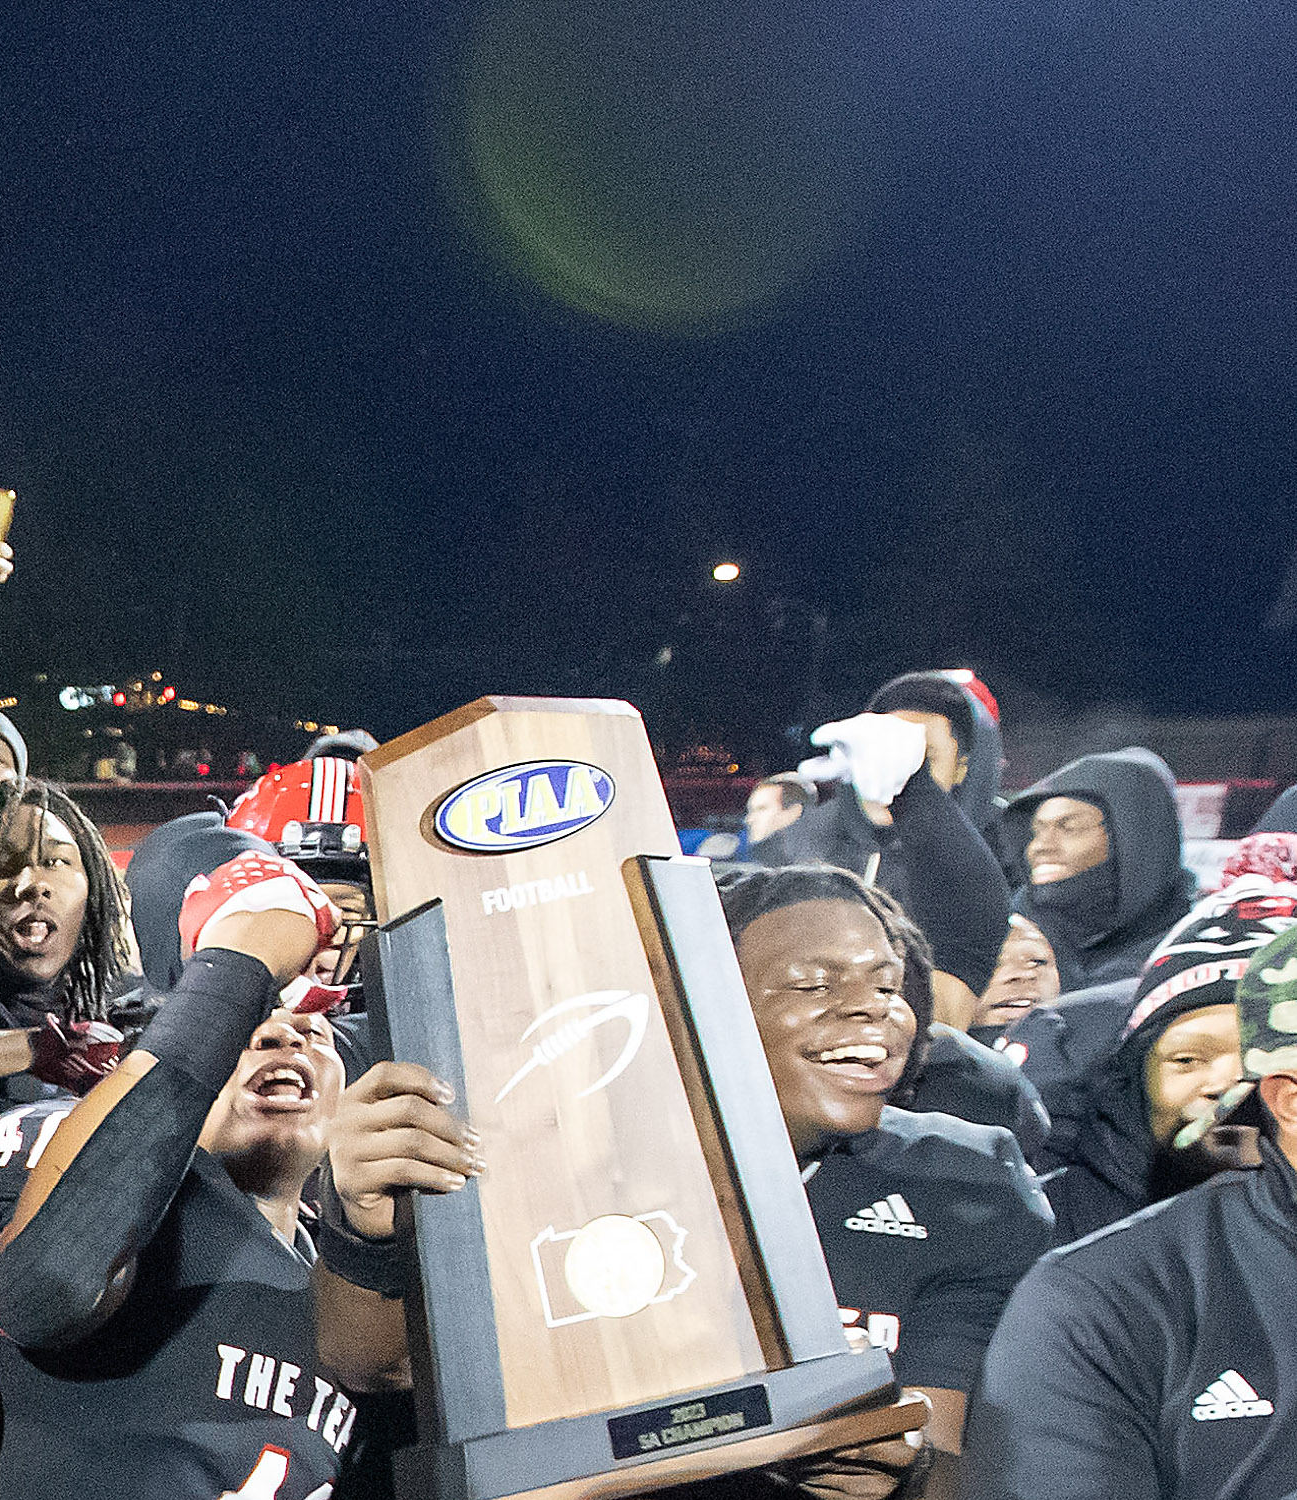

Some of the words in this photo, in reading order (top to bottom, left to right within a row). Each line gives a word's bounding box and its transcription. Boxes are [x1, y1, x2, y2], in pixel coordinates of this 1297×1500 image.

[463, 765, 606, 838] PIAA
[484, 875, 595, 915] FOOTBALL
[845, 1216, 928, 1240] adidas
[215, 1343, 302, 1419] THE
[1191, 1399, 1275, 1421] adidas
